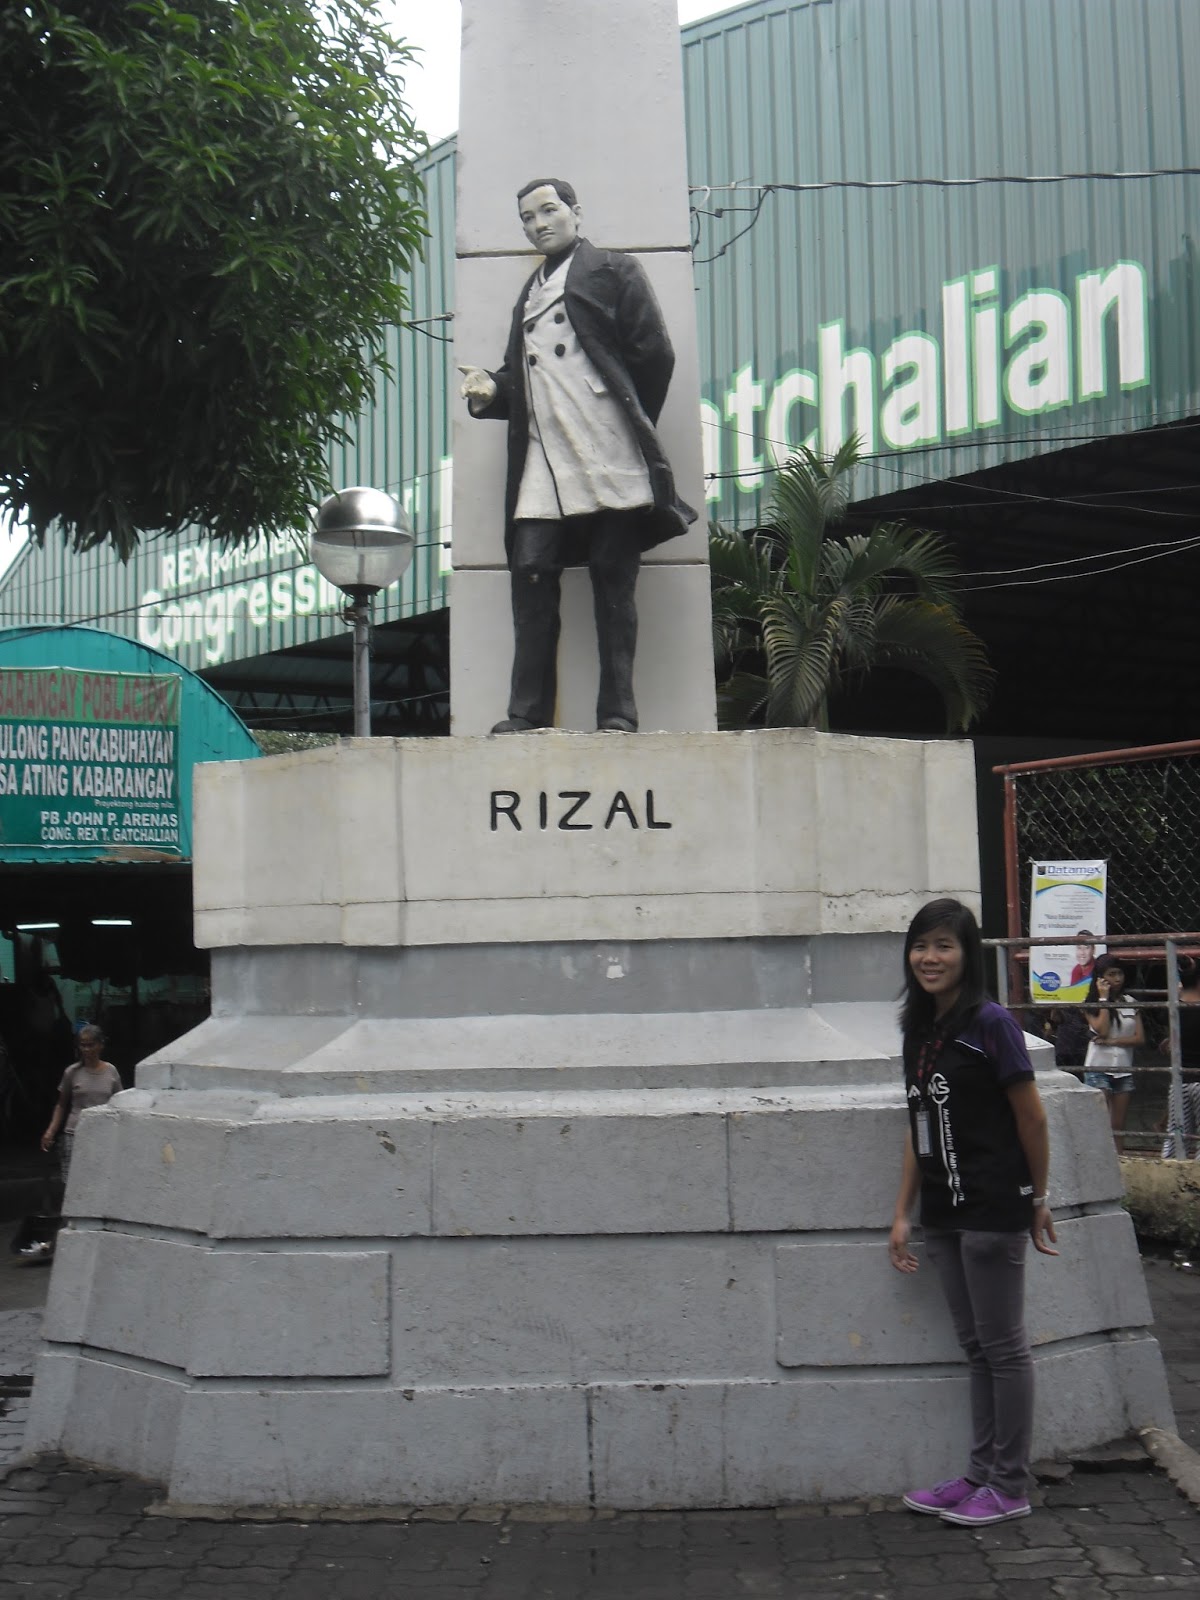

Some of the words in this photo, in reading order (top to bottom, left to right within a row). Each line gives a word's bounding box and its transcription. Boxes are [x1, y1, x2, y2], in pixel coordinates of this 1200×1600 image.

[52, 726, 174, 764] PANGKABUHAYAN
[0, 764, 18, 795] SA
[22, 765, 68, 796] ATING
[72, 766, 174, 799] KABARANGAY
[40, 811, 60, 825] PB
[63, 811, 104, 826] JOHN
[107, 812, 118, 826] P.
[122, 813, 178, 827] ARENAS
[490, 789, 672, 832] RIZAL
[41, 827, 75, 841] CONG.
[77, 827, 98, 841] REX
[101, 828, 110, 841] T.
[113, 828, 178, 843] GATCHALIAN
[1048, 866, 1101, 874] Datamex
[942, 1108, 954, 1151] Marketing
[949, 1152, 965, 1202] Mangemnt
